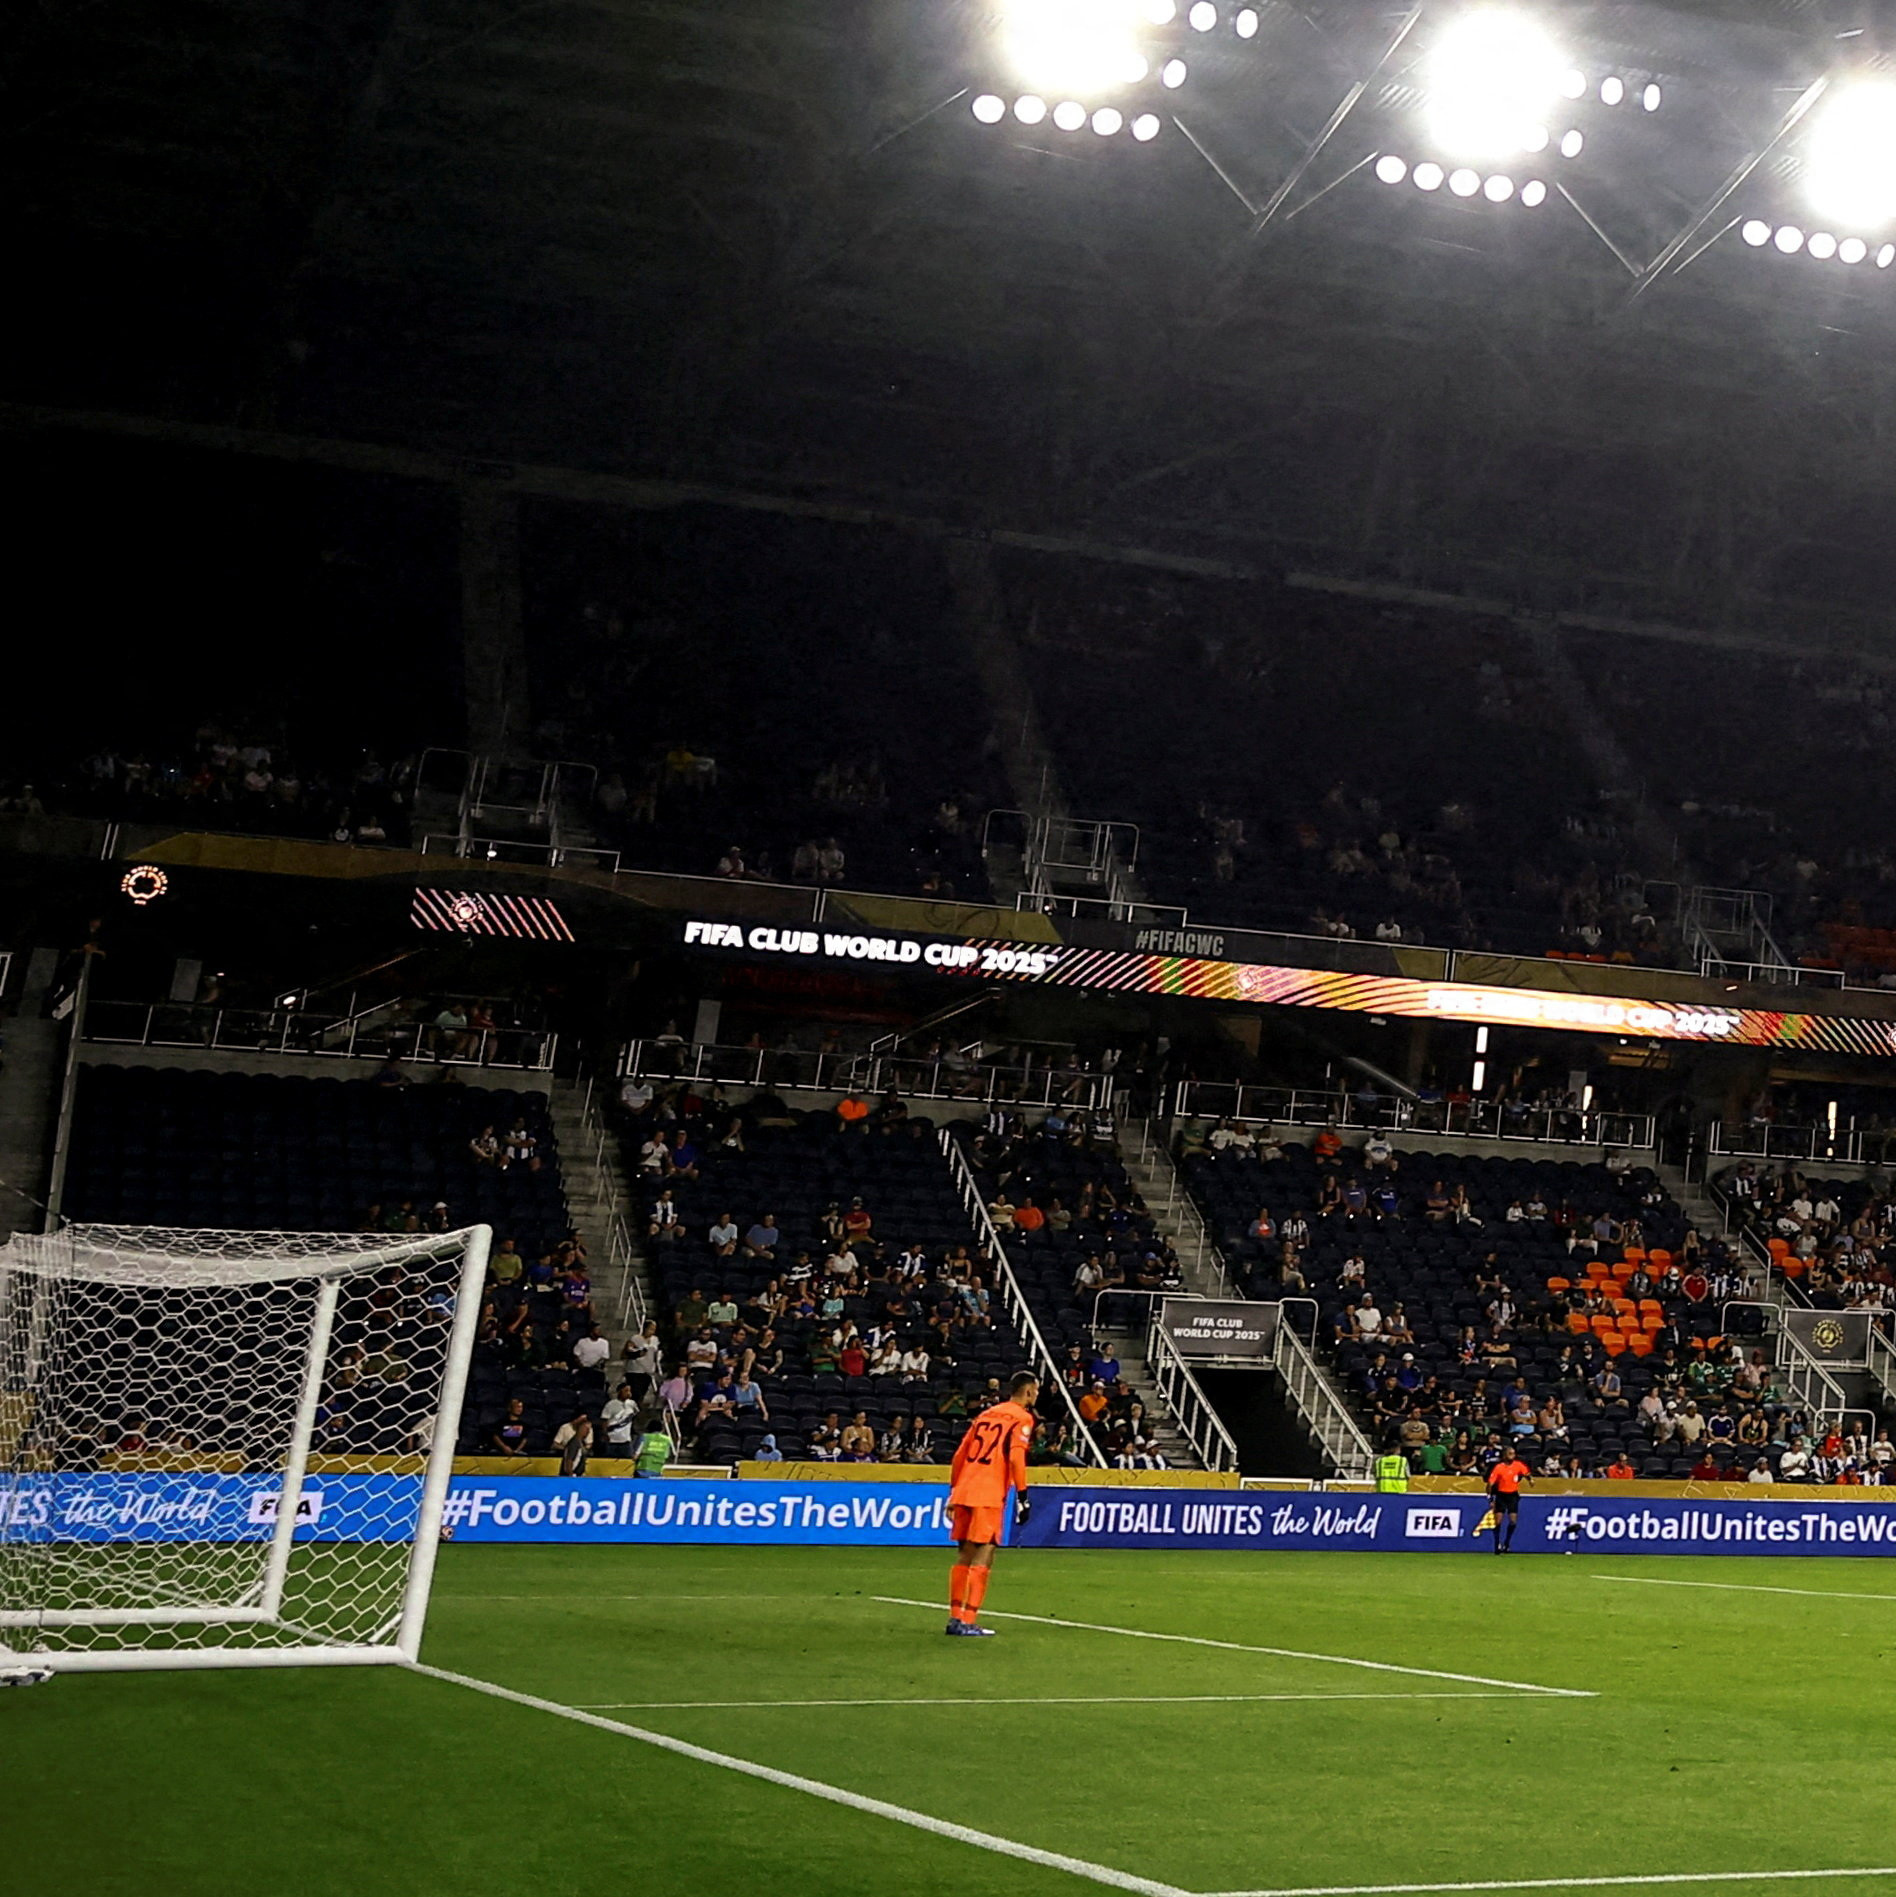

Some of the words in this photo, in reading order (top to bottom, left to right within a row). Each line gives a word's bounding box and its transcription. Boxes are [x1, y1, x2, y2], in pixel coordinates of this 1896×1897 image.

[684, 921, 744, 948] FIFA
[748, 927, 820, 954] CLUB
[824, 934, 920, 963] WORLD
[924, 943, 979, 968] CUP
[1135, 928, 1225, 957] #FIFACWC
[1627, 1007, 1672, 1029] CUP
[1173, 1328, 1211, 1339] WORLD
[1212, 1330, 1234, 1339] CUP
[1193, 1317, 1214, 1328] FIFA
[1216, 1318, 1243, 1328] CLUB
[966, 1422, 1003, 1465] 52
[119, 1489, 216, 1526] World
[1060, 1501, 1176, 1533] FOOTBALL
[1182, 1504, 1262, 1535] UNITES
[1270, 1506, 1310, 1535] the
[1311, 1505, 1382, 1539] World
[1414, 1516, 1452, 1531] FIFA
